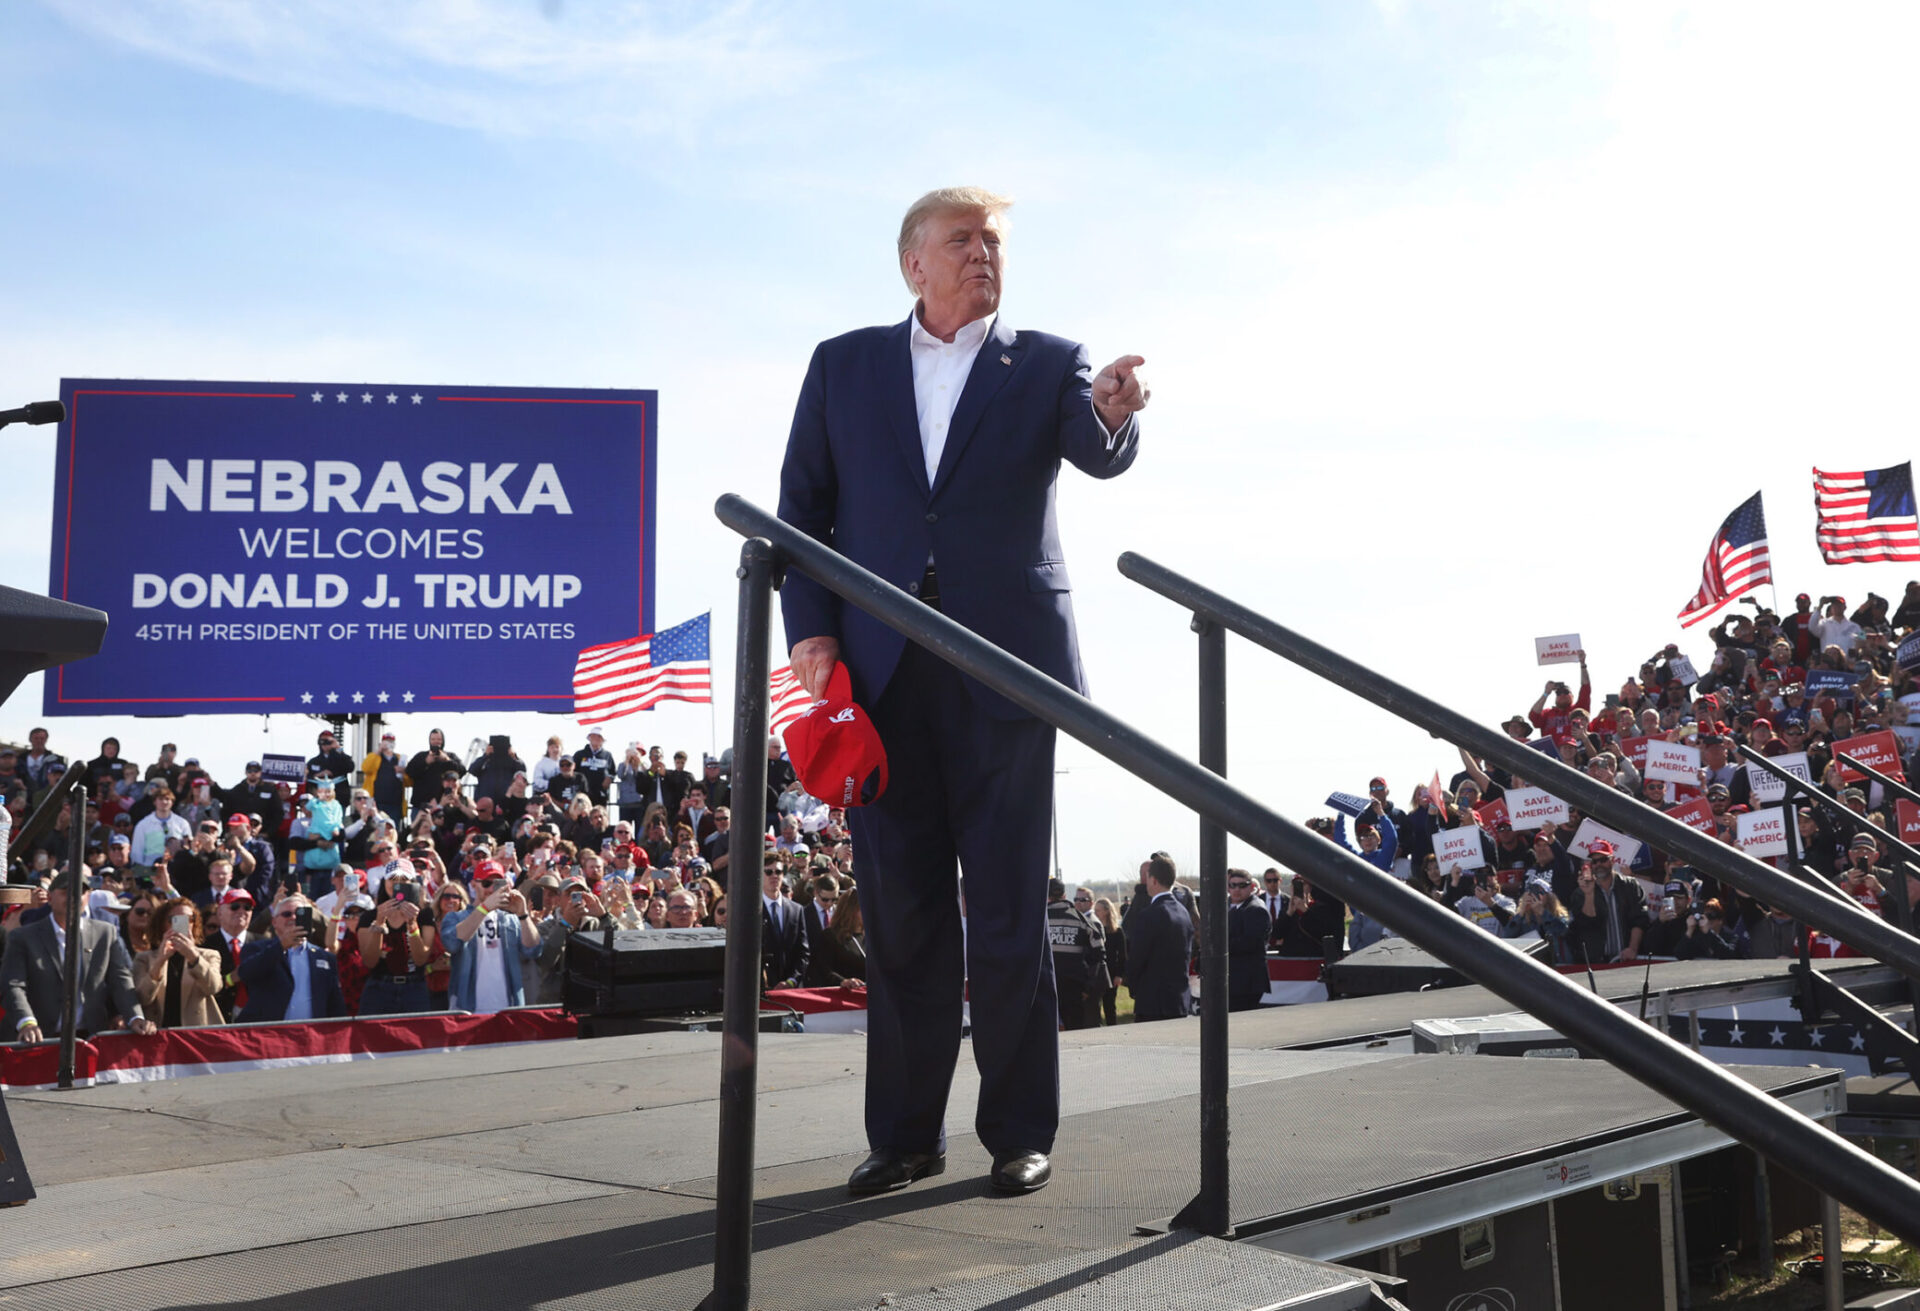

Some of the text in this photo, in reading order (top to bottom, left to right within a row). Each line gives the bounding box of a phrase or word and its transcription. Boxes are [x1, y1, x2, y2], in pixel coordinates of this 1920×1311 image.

[150, 459, 573, 515] NEBRASKA
[238, 528, 484, 560] WELCOMES
[132, 573, 582, 609] DONALD J. TRUMP
[135, 623, 576, 641] 45TH PRESIDENT OF THE UNITED STATES
[1548, 642, 1569, 650] SAVE
[1541, 650, 1578, 659] AMERICA
[1820, 675, 1845, 683] SAVE
[1663, 751, 1687, 762] SAVE
[1850, 744, 1879, 758] SAVE
[1651, 761, 1698, 774] AMERICA!
[1841, 753, 1894, 772] ARICA!
[1524, 795, 1551, 807] SAVE
[1515, 805, 1563, 819] AMERICA!
[1753, 820, 1780, 832] SAVE
[1443, 838, 1465, 850] SAVE
[1440, 848, 1478, 862] AMERICA!
[1052, 934, 1076, 945] POLICE
